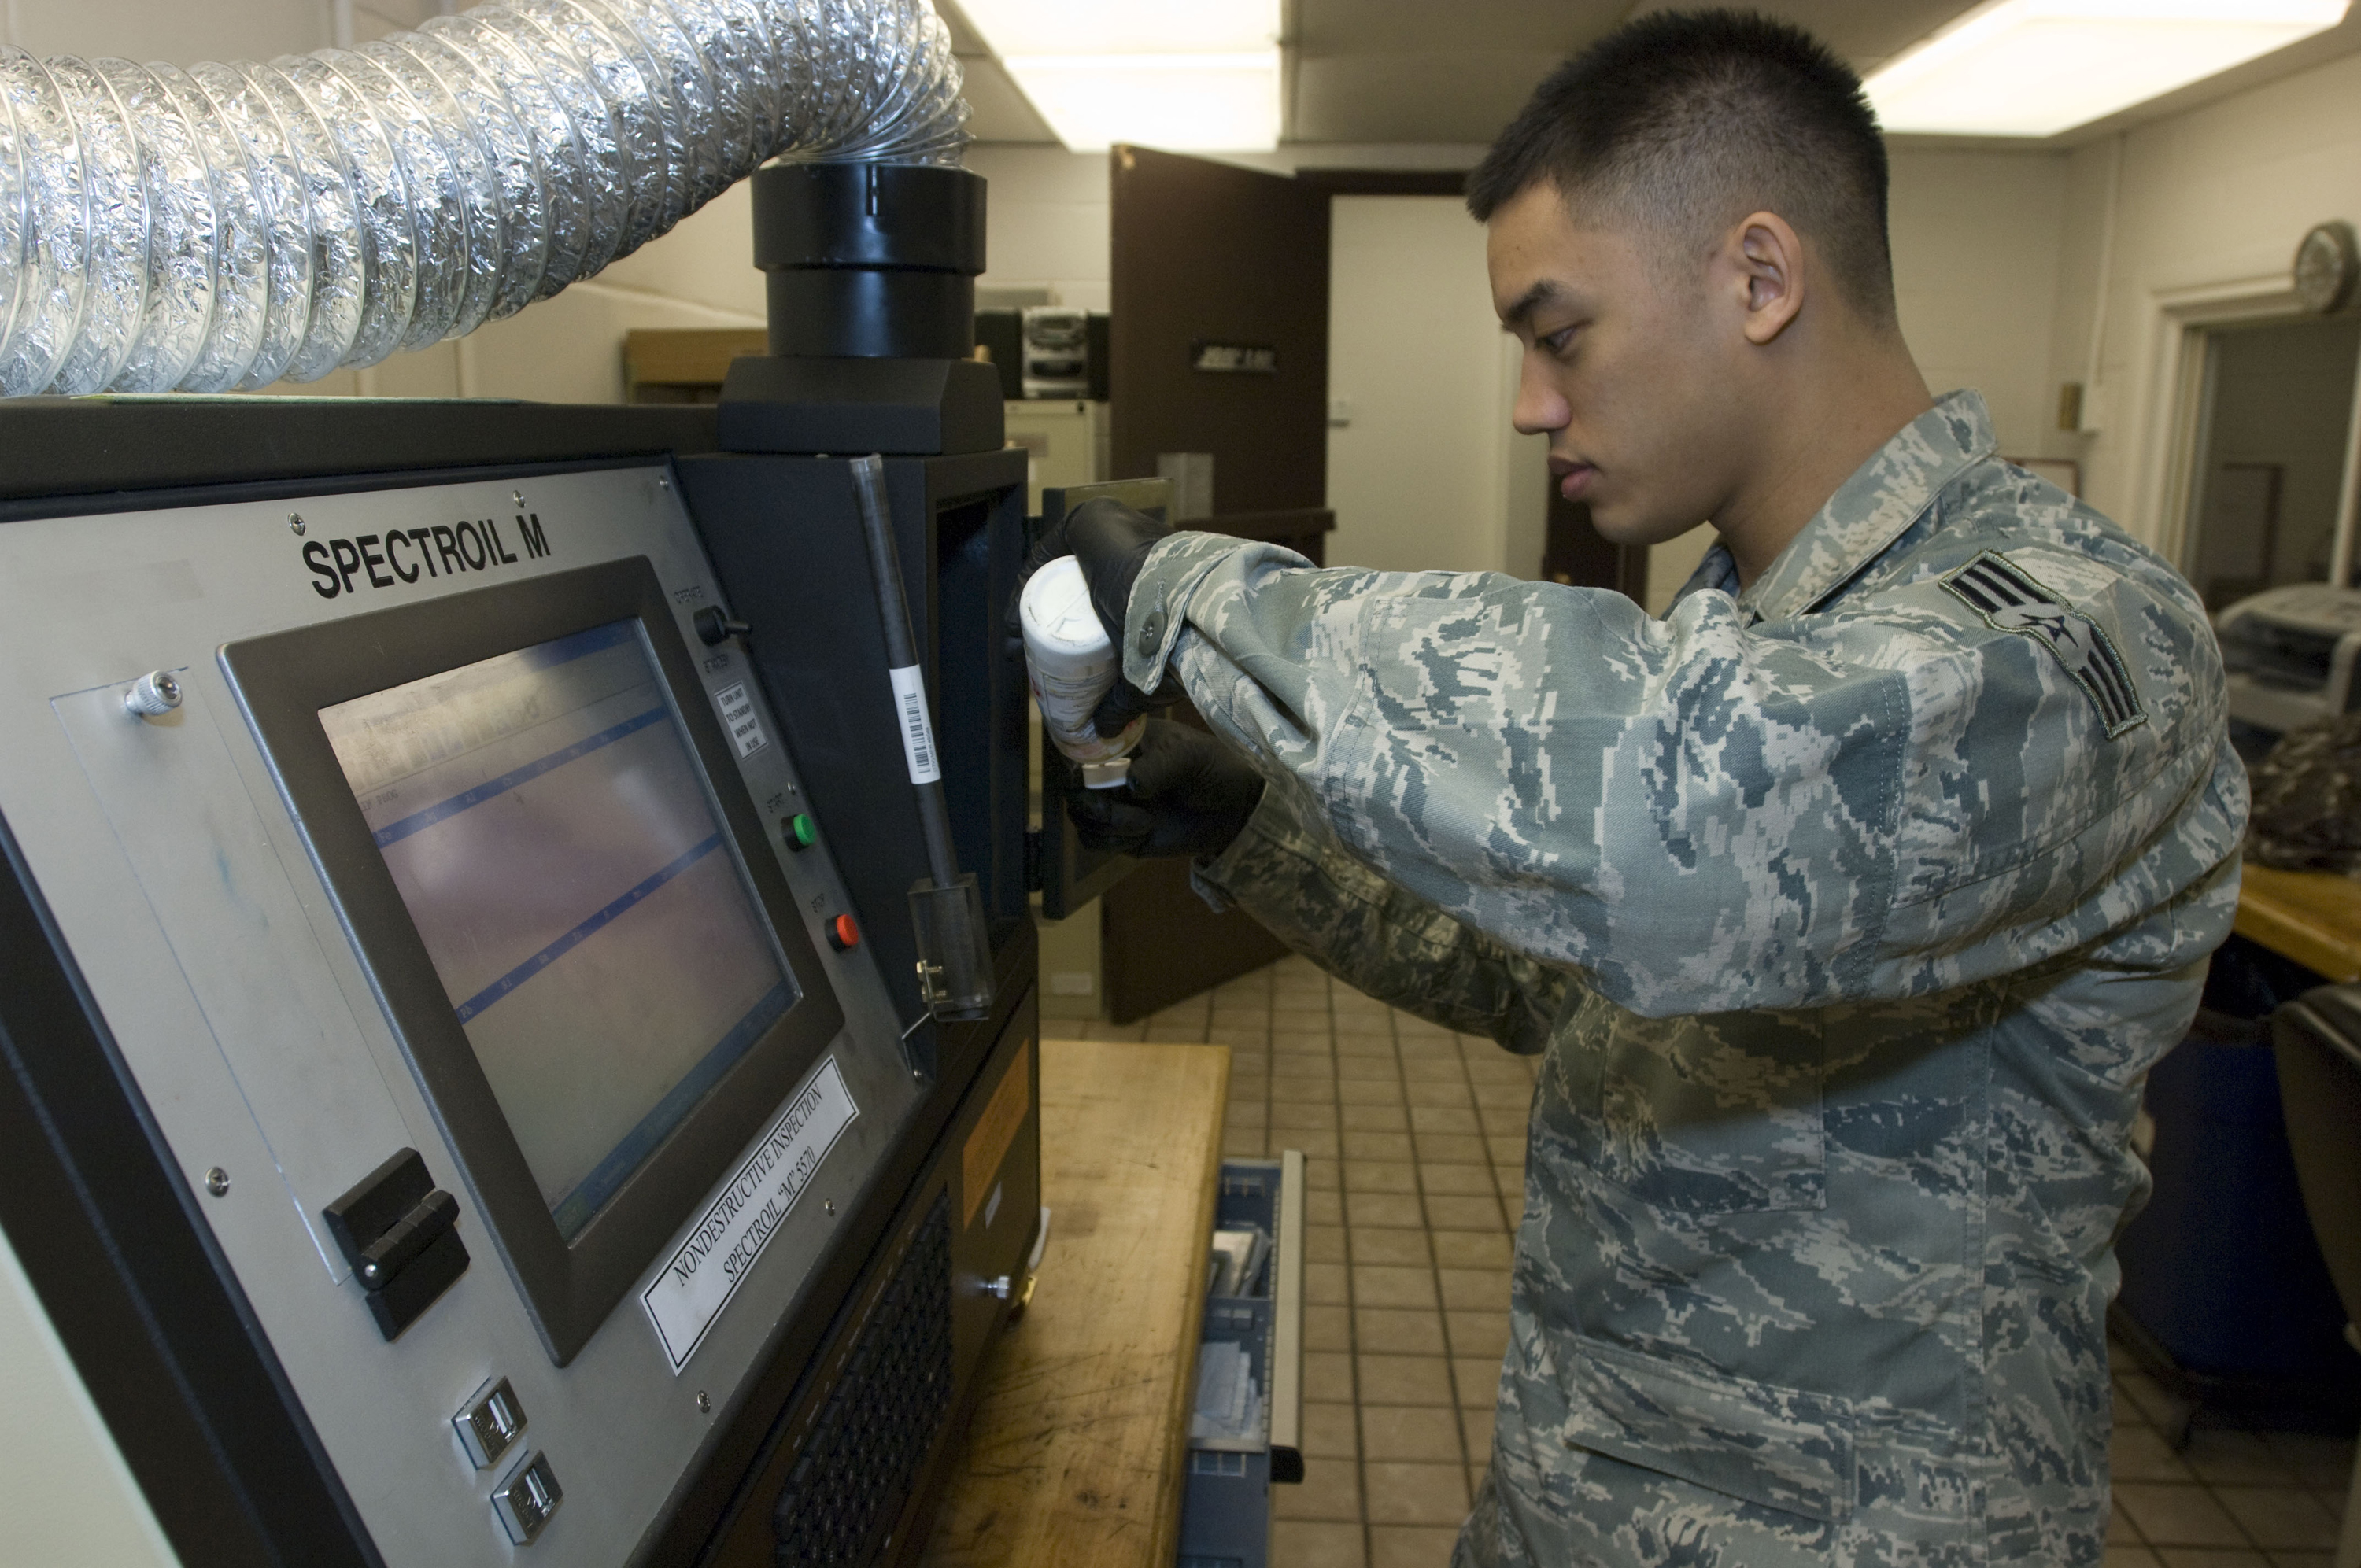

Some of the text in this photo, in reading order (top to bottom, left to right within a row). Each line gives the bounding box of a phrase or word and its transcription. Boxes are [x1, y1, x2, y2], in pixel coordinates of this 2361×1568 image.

[302, 513, 551, 600] SPECTROIL M
[721, 688, 744, 707] TURN UNIT
[726, 703, 752, 723] TO STANDBY
[734, 718, 756, 738] WHEN NOT
[745, 736, 759, 752] IN USE
[673, 1083, 822, 1288] NONDESTRUCTIVE INSPECTION
[723, 1199, 781, 1283] SPECTROIL
[796, 1146, 815, 1182] 5570
